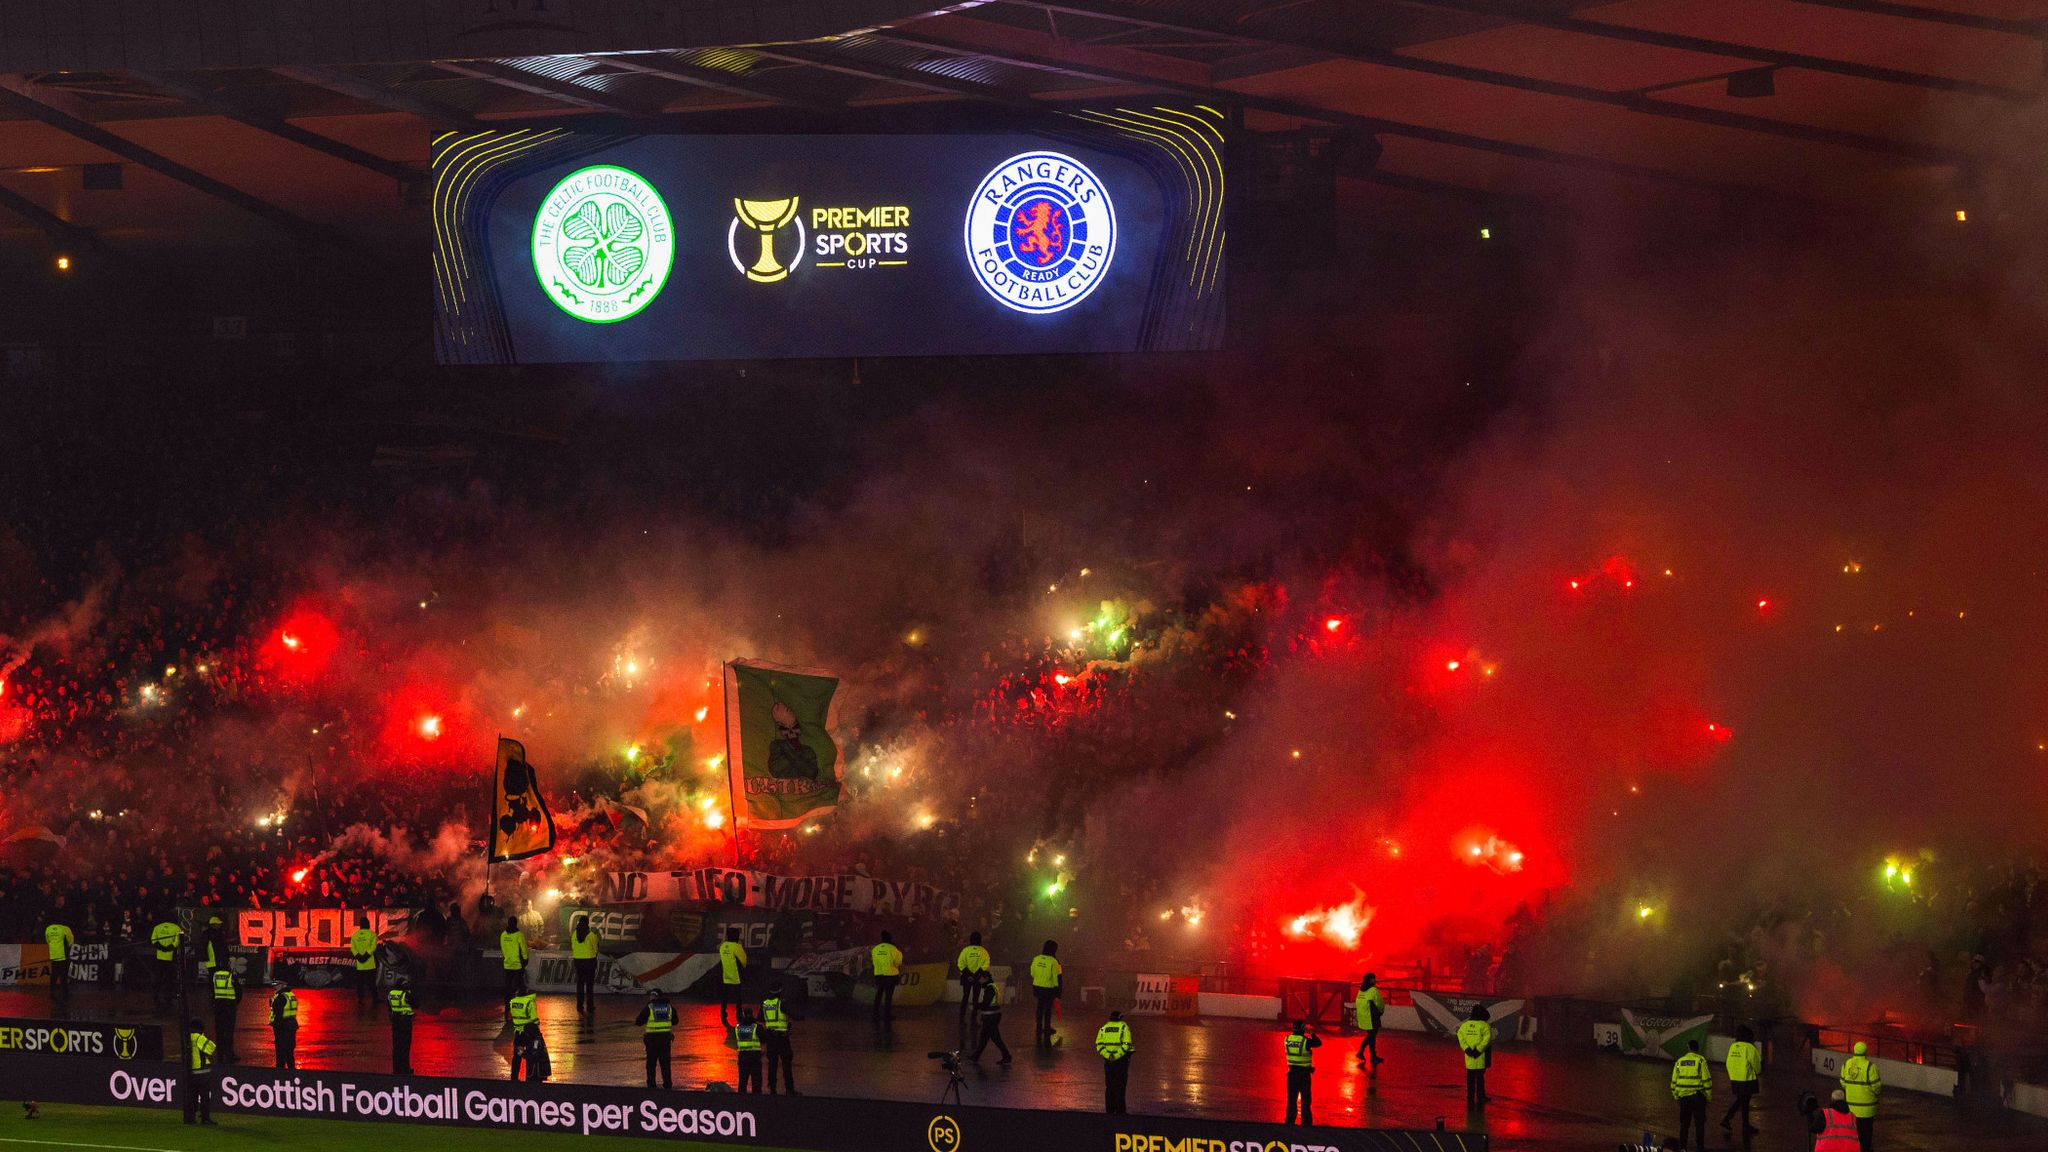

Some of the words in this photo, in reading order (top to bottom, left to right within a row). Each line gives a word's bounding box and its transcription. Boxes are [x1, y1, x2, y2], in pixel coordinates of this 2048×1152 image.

[985, 162, 1096, 205] RANGERS
[540, 213, 555, 246] THE
[548, 180, 584, 218] CELTIC
[586, 173, 652, 207] FOOTBALL
[646, 204, 667, 243] CLUB
[812, 206, 910, 229] PREMIER
[816, 231, 908, 256] SPORTS
[847, 258, 876, 269] CUP
[979, 248, 1067, 302] FOOTBALL
[1068, 244, 1103, 290] CLUB
[1022, 268, 1060, 281] READY
[590, 299, 618, 313] 1888
[600, 872, 648, 903] NO
[309, 956, 330, 965] BEST
[67, 961, 99, 981] ONE
[1606, 1031, 1618, 1044] 39
[1823, 1057, 1835, 1071] 40
[109, 1070, 177, 1102] Over
[221, 1076, 335, 1113] Scottish
[341, 1083, 458, 1120] Football
[464, 1090, 576, 1127] Games
[582, 1101, 634, 1136] per
[639, 1099, 756, 1137] Season
[934, 1127, 954, 1144] PS
